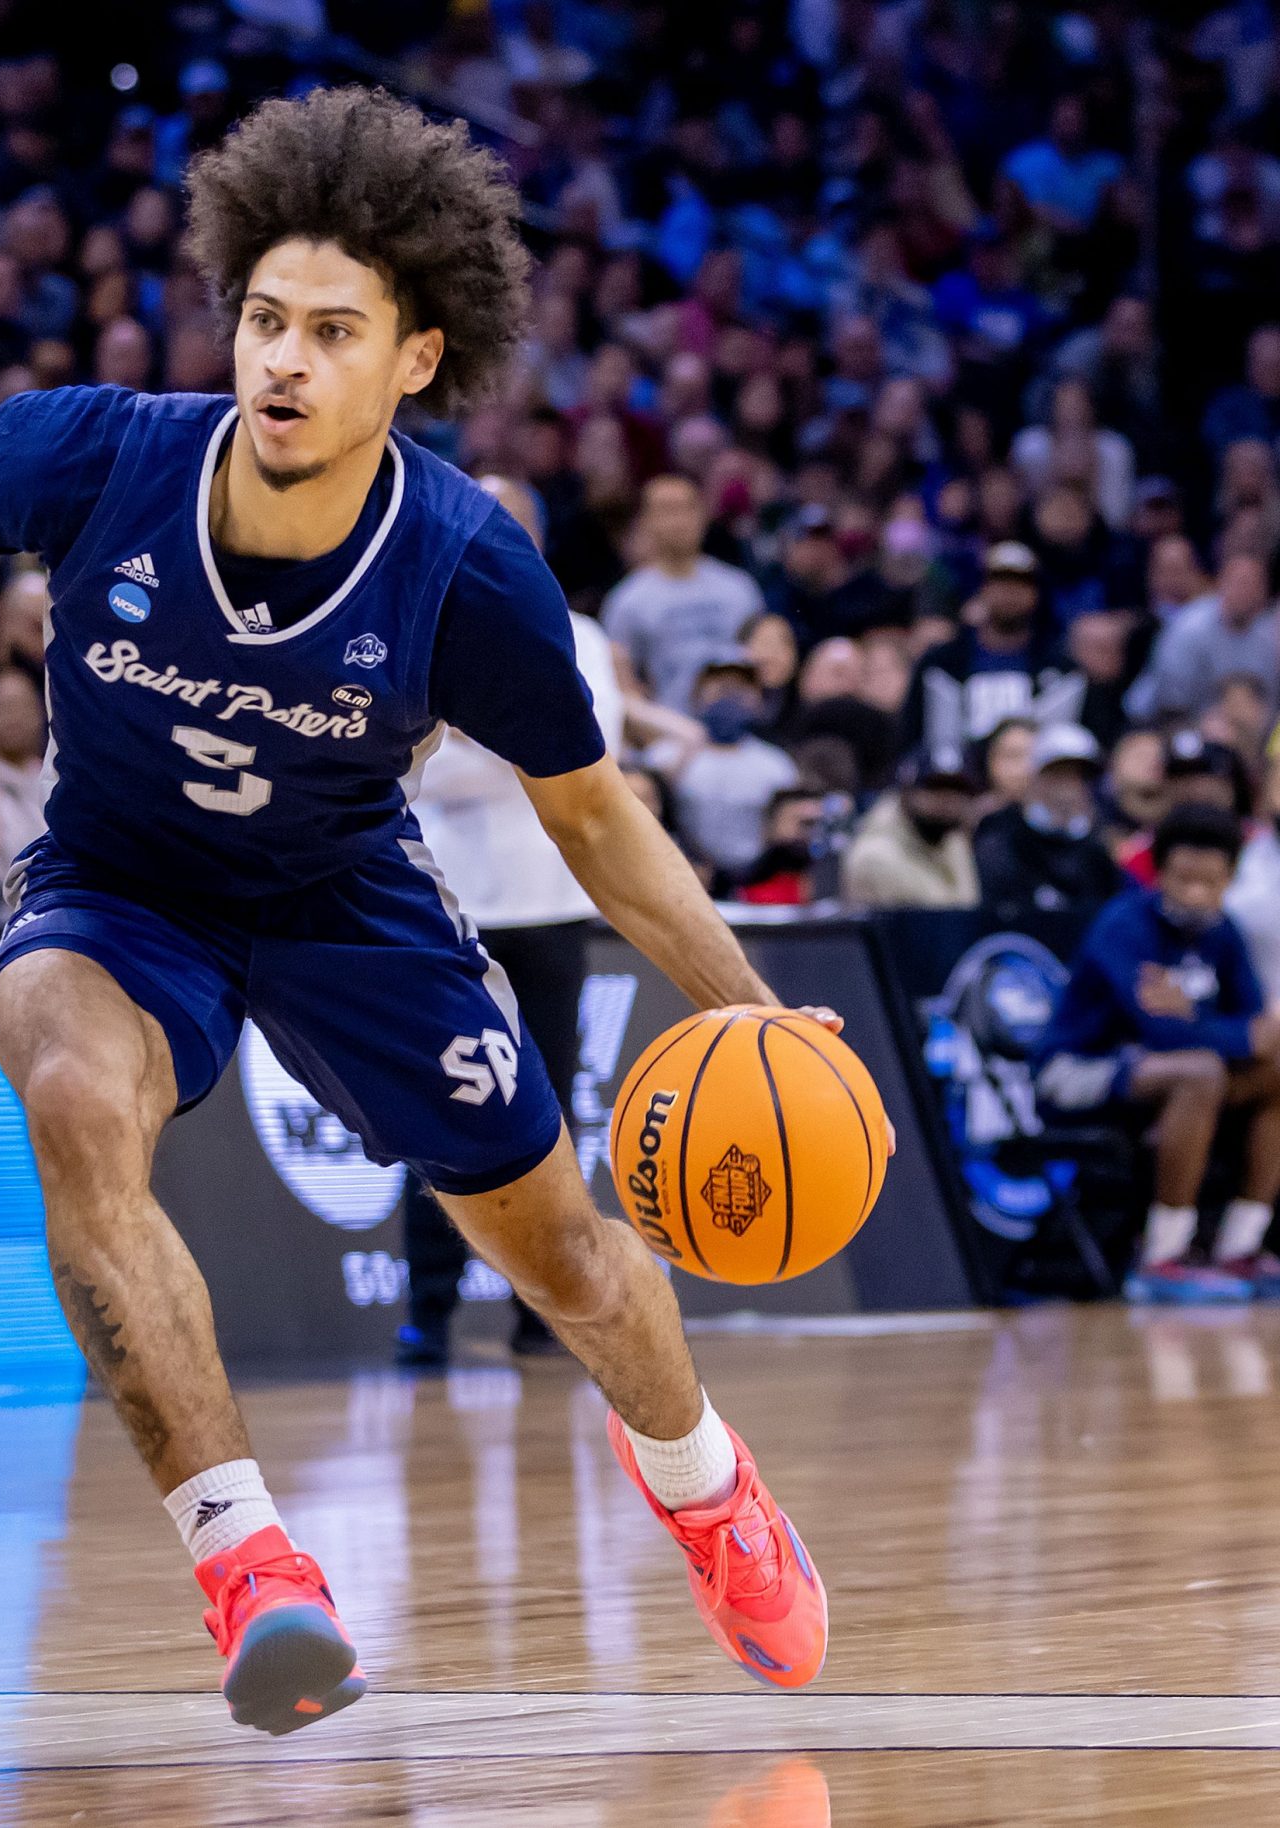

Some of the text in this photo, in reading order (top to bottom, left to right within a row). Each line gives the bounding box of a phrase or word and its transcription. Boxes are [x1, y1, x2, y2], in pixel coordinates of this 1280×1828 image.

[114, 566, 160, 588] adidas
[112, 595, 146, 620] NCAA
[83, 639, 222, 708] Saint
[334, 689, 370, 707] BLM
